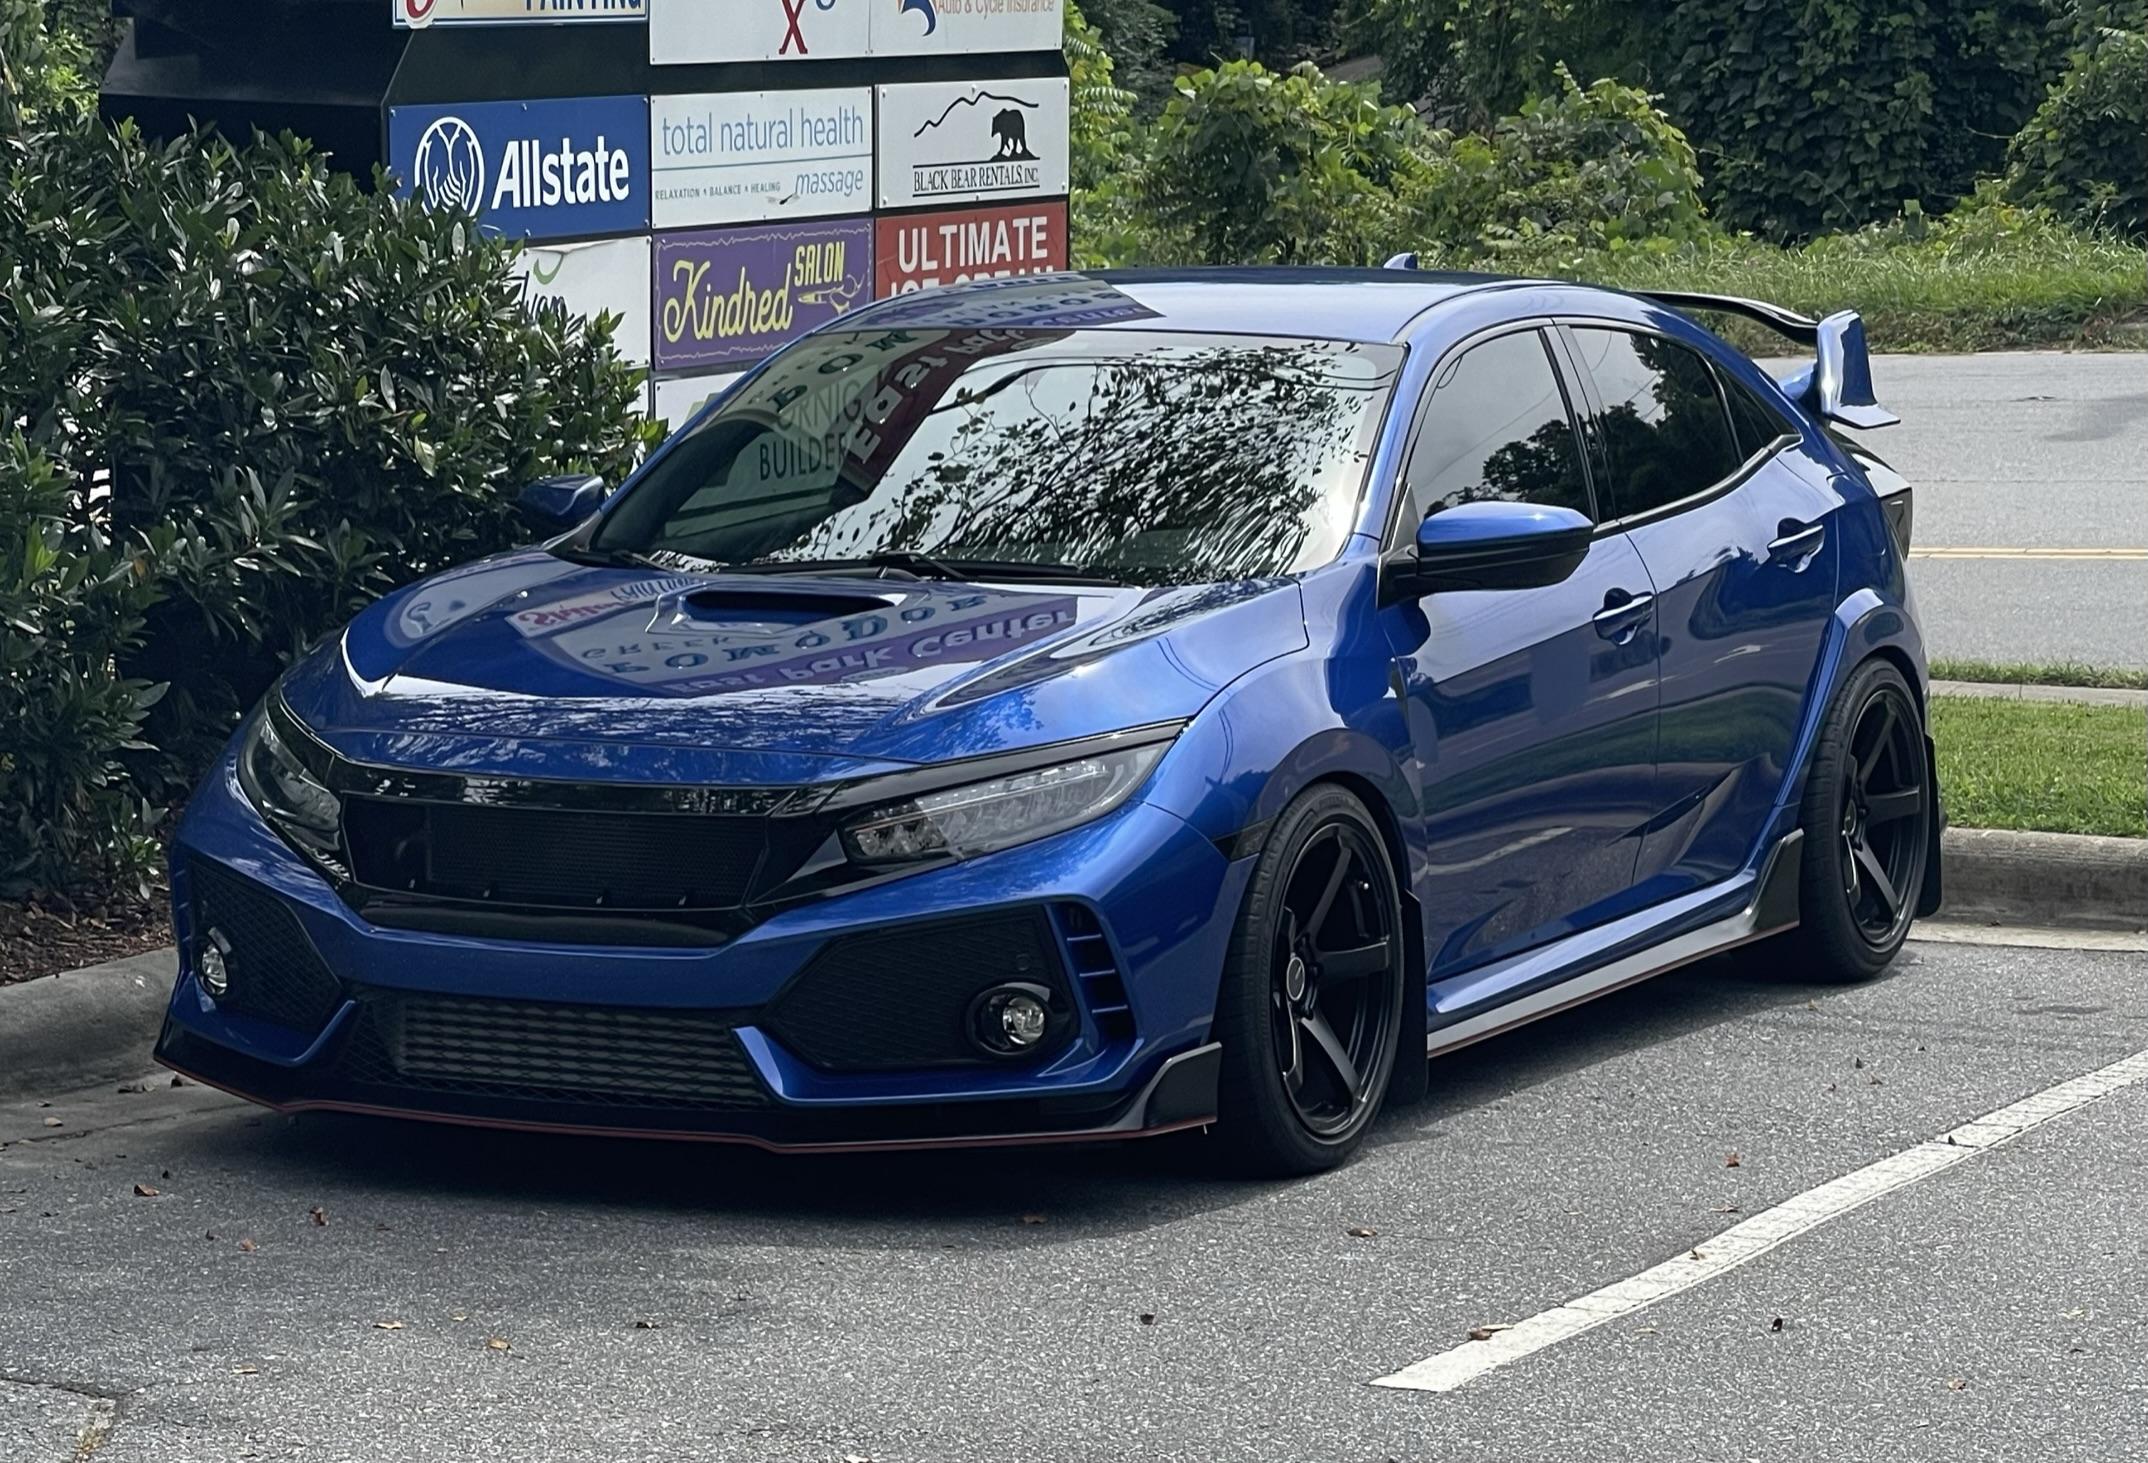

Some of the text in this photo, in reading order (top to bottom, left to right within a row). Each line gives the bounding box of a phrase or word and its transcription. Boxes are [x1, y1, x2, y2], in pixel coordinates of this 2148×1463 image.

[662, 104, 864, 156] total natural health
[491, 136, 629, 210] Allstate
[655, 181, 781, 200] RELAXATION BALANCE HEALING
[794, 169, 864, 197] massage
[914, 169, 949, 192] BLACK
[951, 167, 978, 189] BEAR
[794, 241, 846, 287] SALON
[898, 216, 1048, 274] ULTIMATE
[663, 260, 793, 343] Kindred
